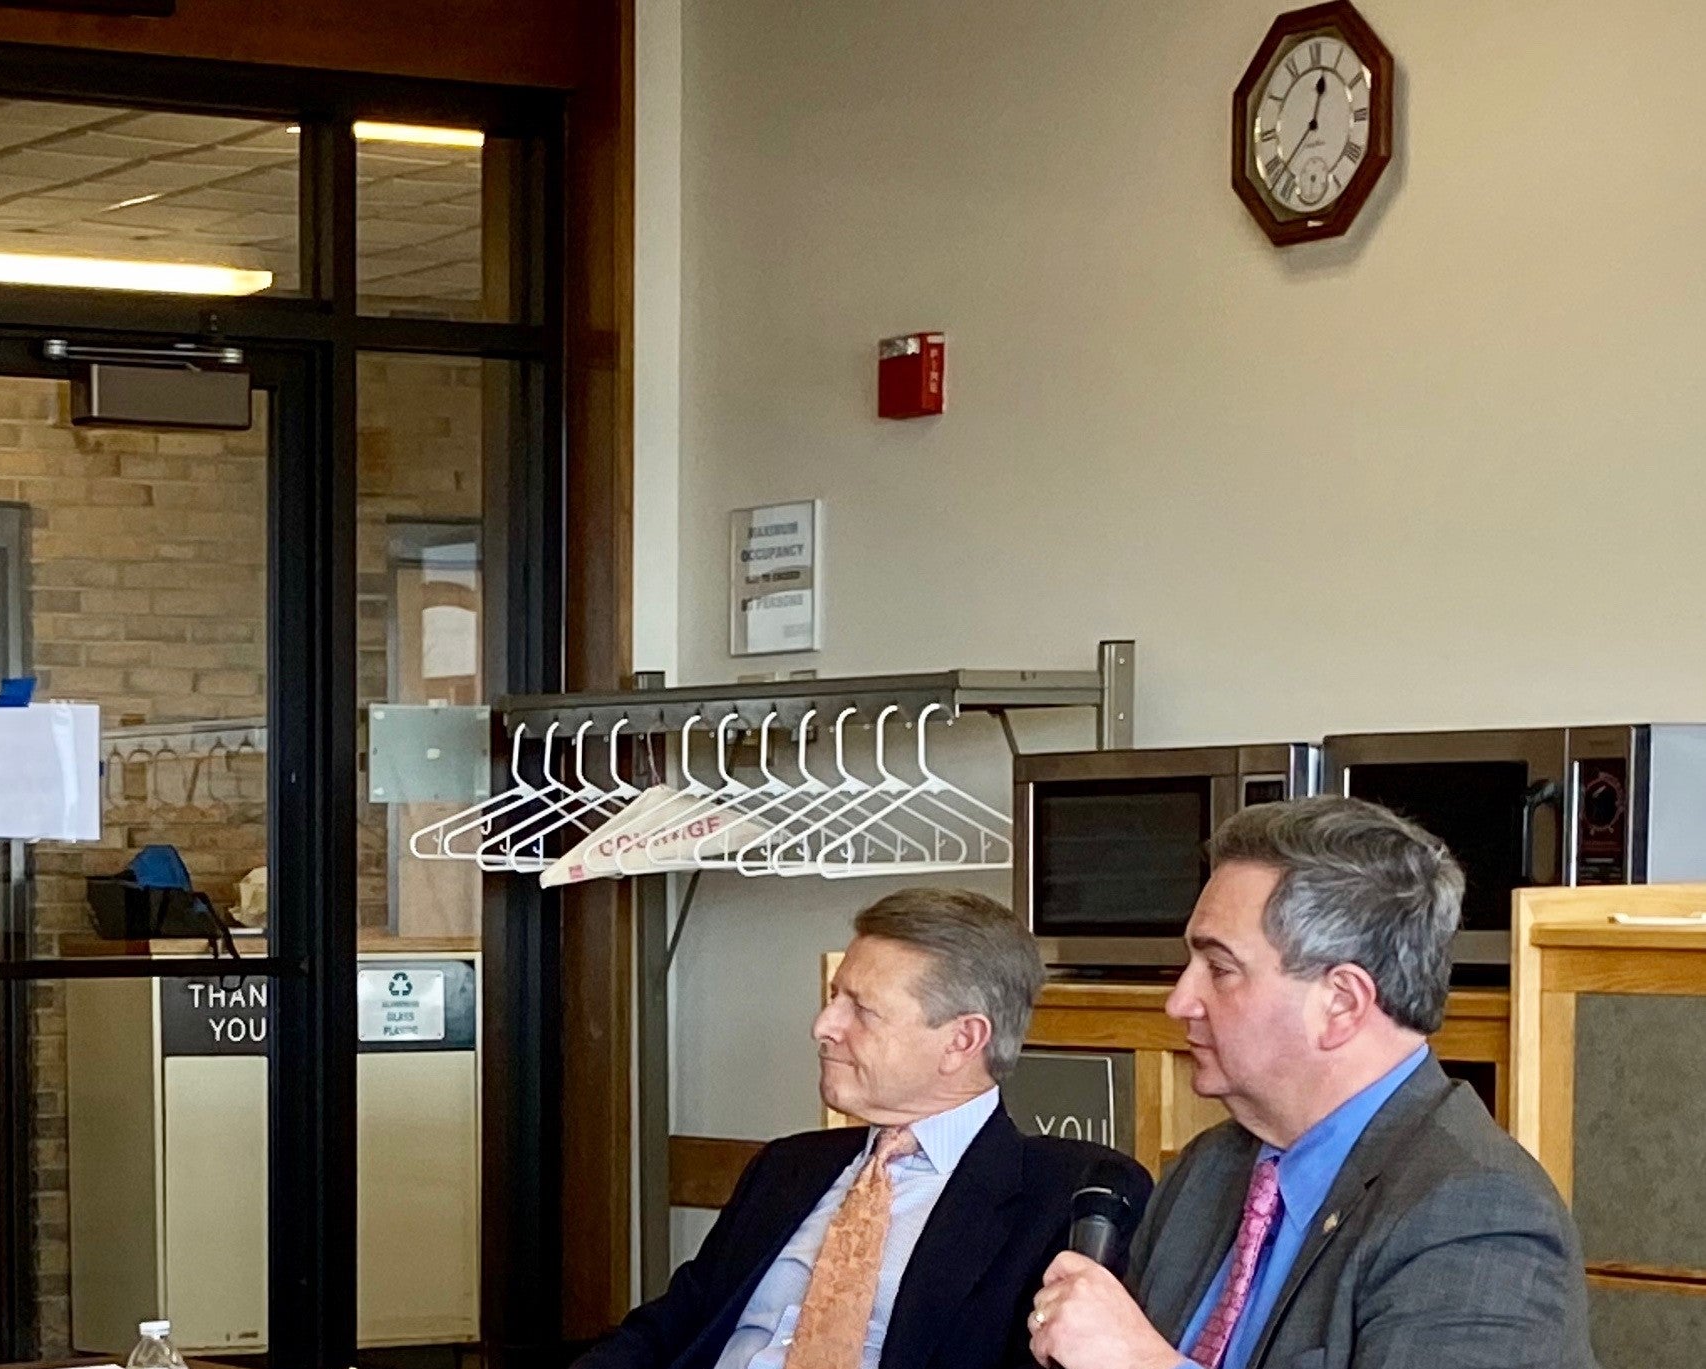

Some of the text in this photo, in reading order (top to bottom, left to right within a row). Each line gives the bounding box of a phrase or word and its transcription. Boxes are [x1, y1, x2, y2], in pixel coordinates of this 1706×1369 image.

[598, 815, 720, 857] COUGE
[187, 983, 267, 1008] THAN
[208, 1017, 267, 1042] YOU
